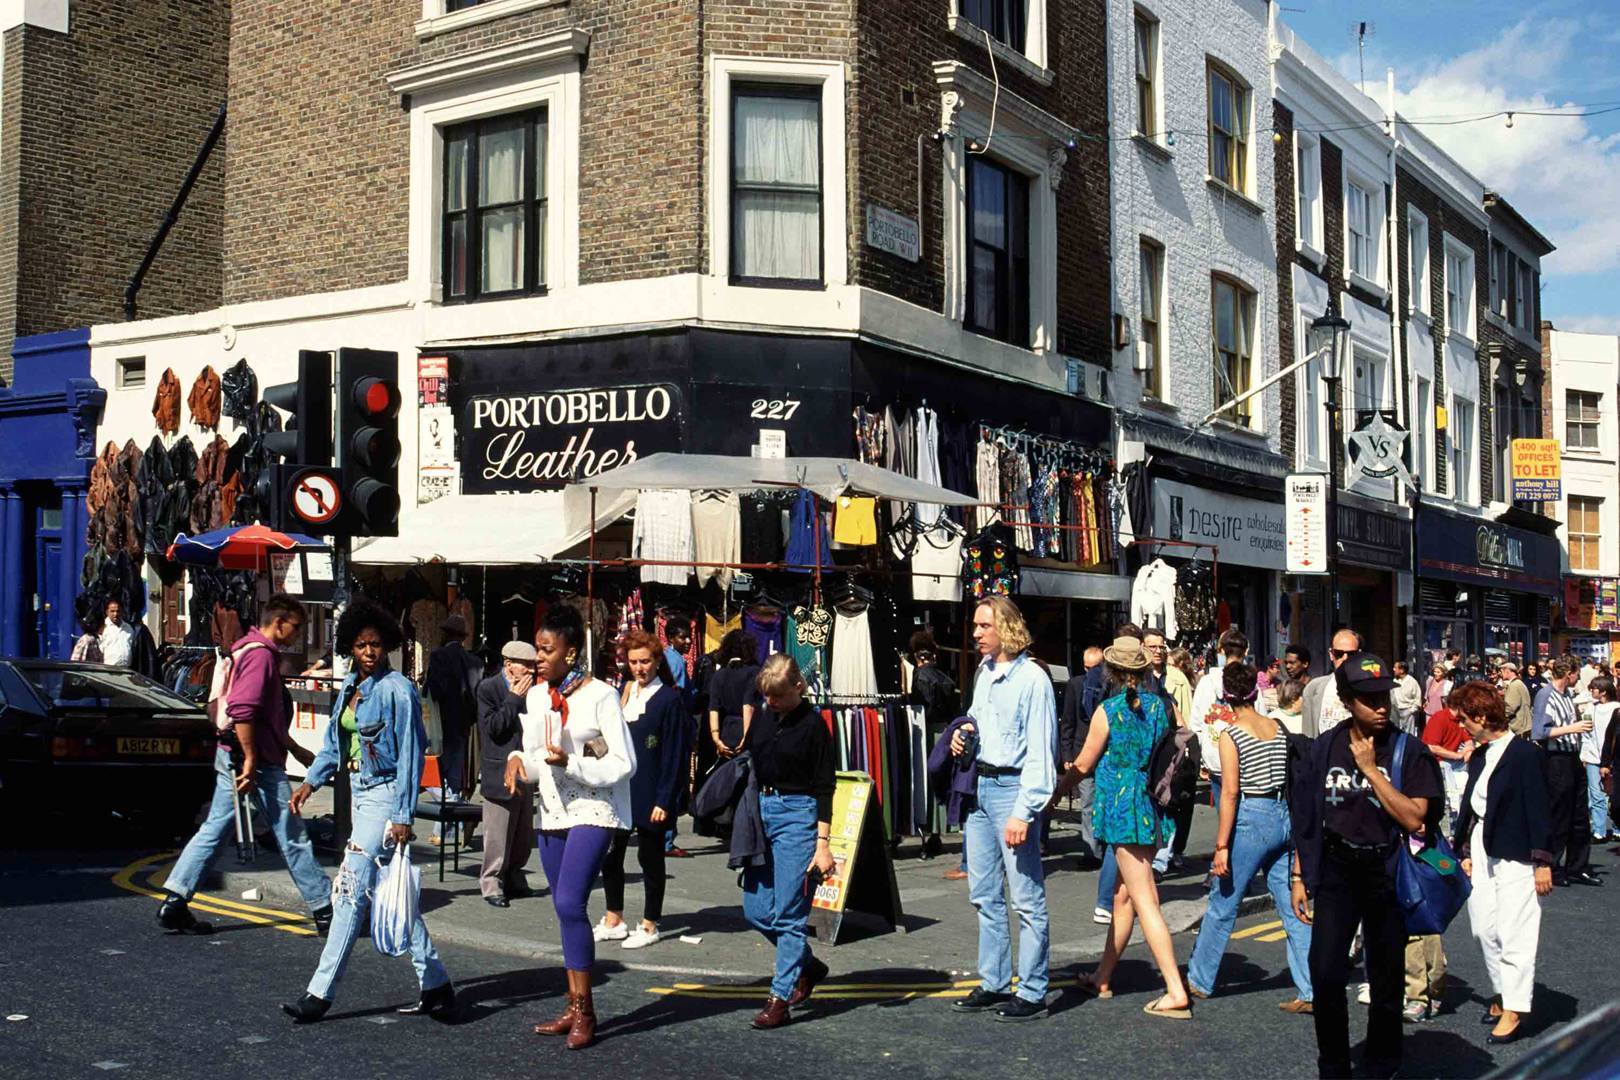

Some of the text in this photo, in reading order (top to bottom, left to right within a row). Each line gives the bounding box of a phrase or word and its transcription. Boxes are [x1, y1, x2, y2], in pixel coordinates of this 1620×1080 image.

[868, 216, 917, 245] PORTOBELLO
[872, 231, 896, 250] ROAD
[474, 387, 671, 428] PORTOBELLO
[751, 399, 800, 420] 227
[1368, 435, 1390, 458] VS
[1518, 453, 1554, 462] OFFICES
[1515, 464, 1558, 476] TO LET
